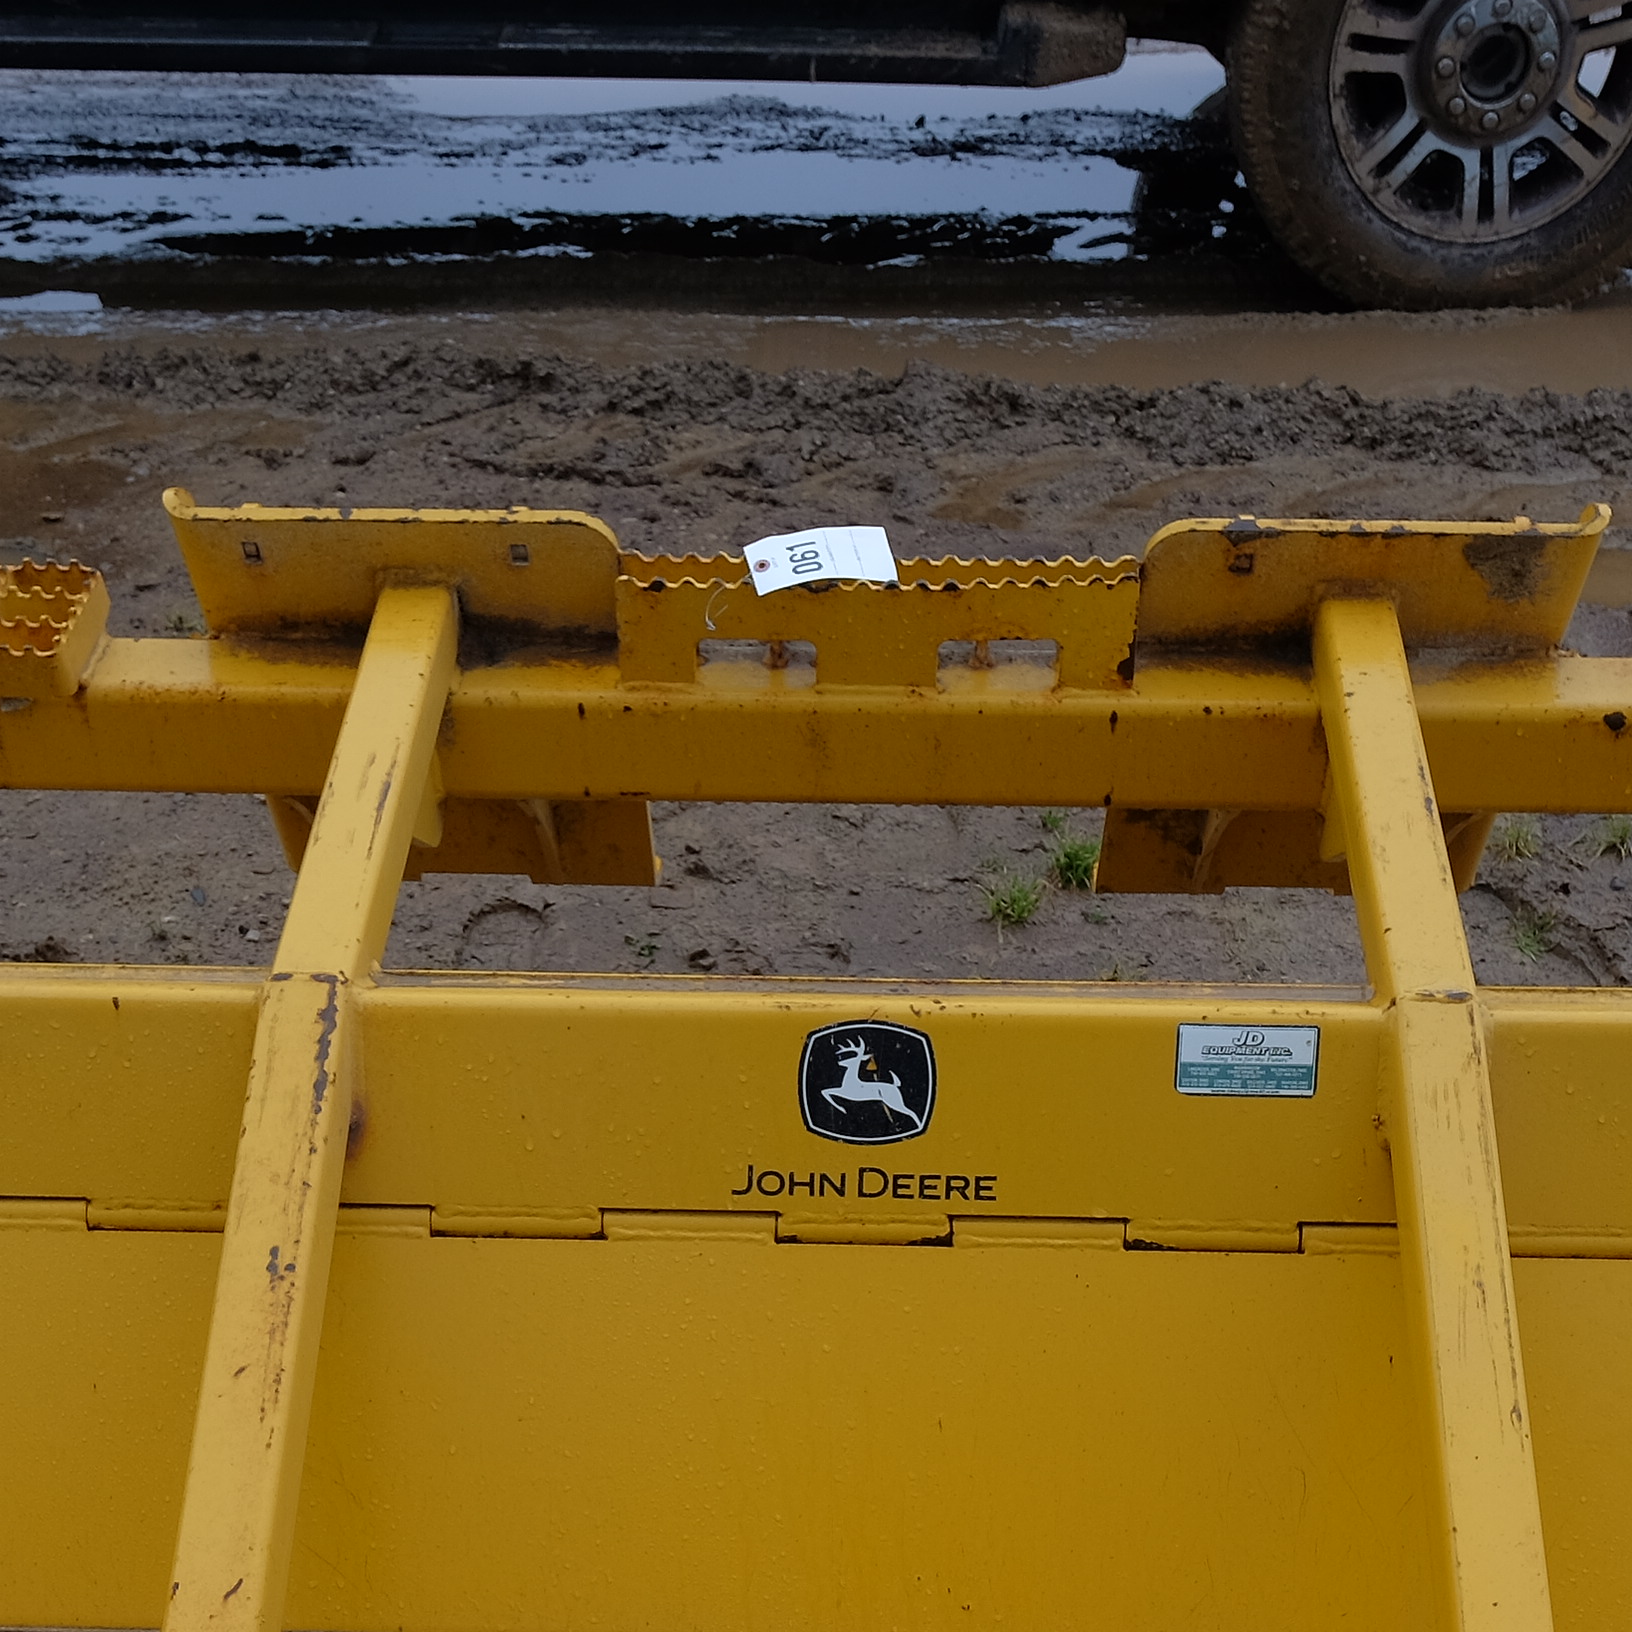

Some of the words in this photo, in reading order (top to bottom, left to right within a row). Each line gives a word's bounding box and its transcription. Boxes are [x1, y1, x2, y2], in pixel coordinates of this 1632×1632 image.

[786, 541, 823, 574] 061
[1201, 1045, 1268, 1057] EQUIPMENT
[1268, 1046, 1293, 1057] INC.
[1232, 1030, 1265, 1047] JD
[731, 1164, 847, 1198] JOHN
[857, 1166, 998, 1202] DEERE
